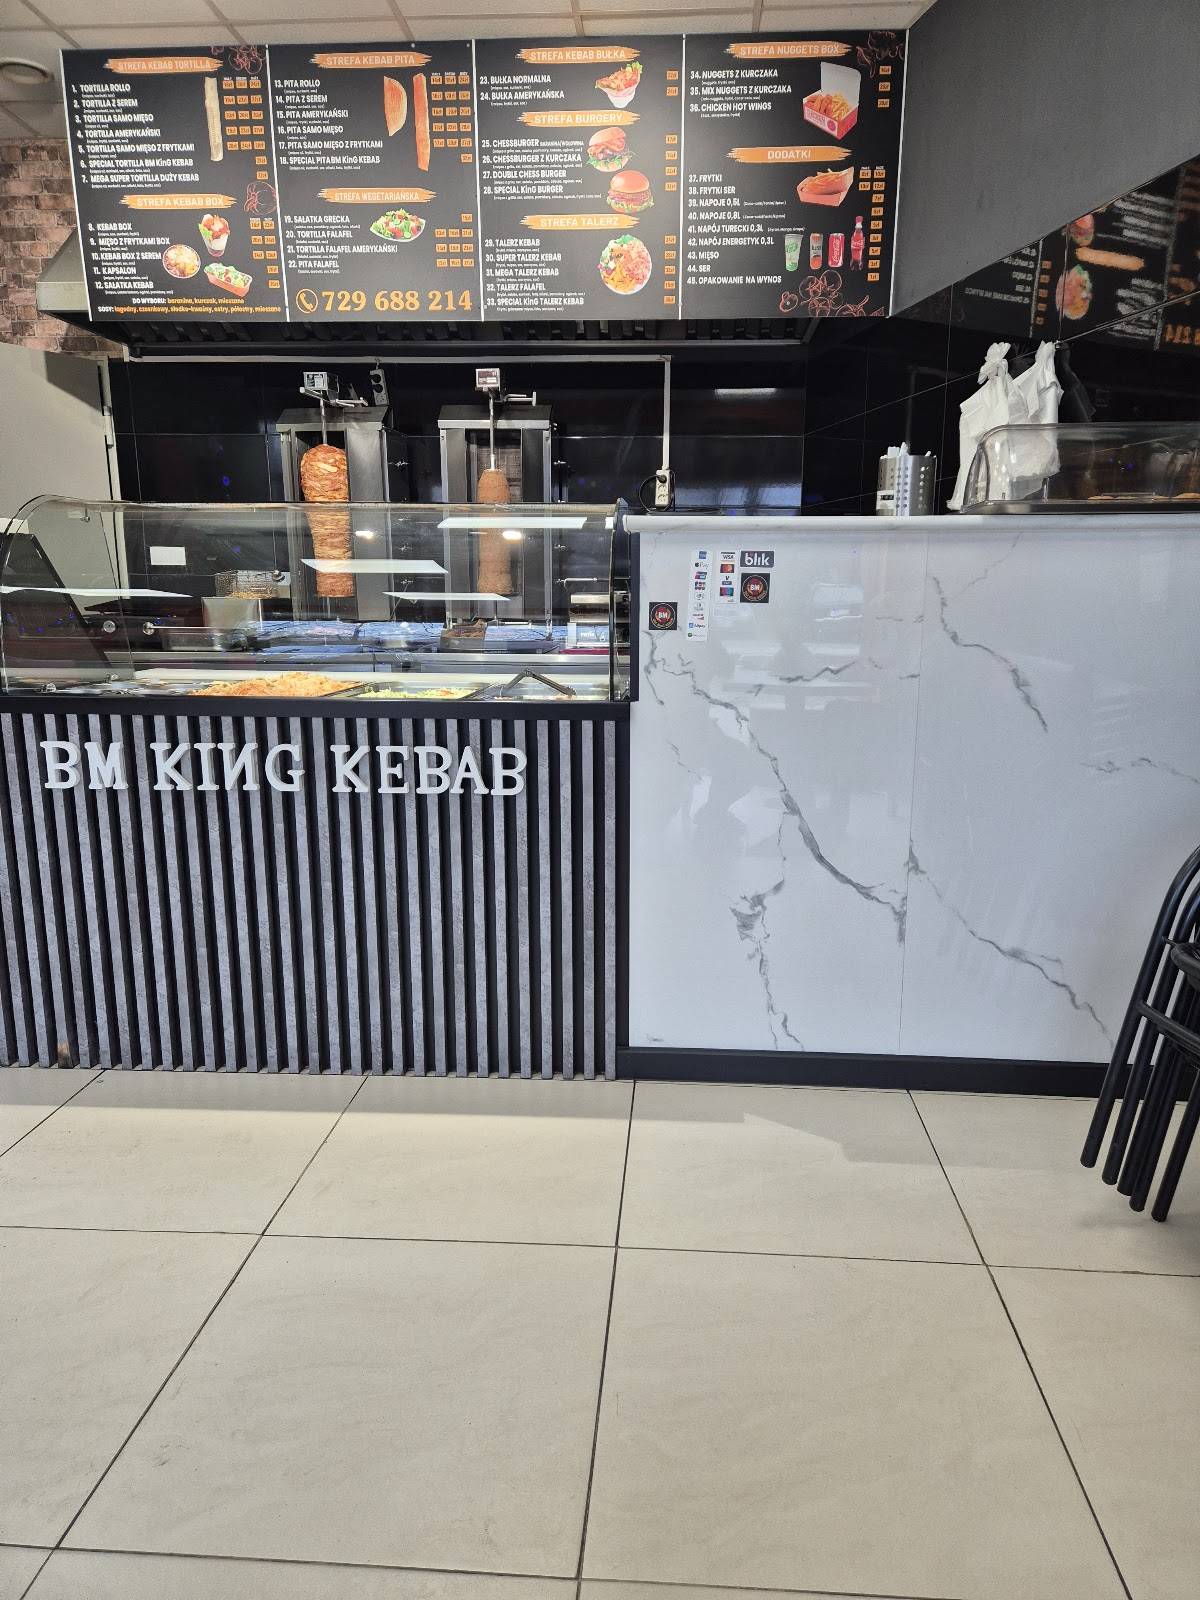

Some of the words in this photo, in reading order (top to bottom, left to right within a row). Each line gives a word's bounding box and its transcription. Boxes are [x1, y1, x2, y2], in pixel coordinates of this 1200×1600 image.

[740, 46, 775, 55] STREFA
[776, 45, 819, 55] NUGGETS
[821, 45, 840, 54] BOX
[326, 56, 361, 65] STREFA
[362, 55, 393, 65] KEBAB
[395, 55, 415, 64] PITA
[530, 51, 563, 61] STREFA
[565, 50, 594, 60] KEBAB
[596, 50, 626, 59] BUŁKA
[702, 70, 734, 78] NUGGETS
[735, 70, 739, 78] Z
[741, 69, 778, 78] KURCZAKA
[300, 79, 320, 87] ROLLO
[491, 76, 512, 84] BUŁKA
[513, 75, 551, 83] NORMALNA
[80, 84, 110, 92] TORTILLA
[110, 84, 131, 92] ROLLO
[702, 87, 715, 95] MIX
[716, 86, 748, 94] NUGGETS
[754, 85, 792, 93] KURCZAKA
[286, 95, 300, 103] PITA
[306, 95, 328, 103] SEREM
[491, 92, 513, 100] BUŁKA
[514, 89, 565, 99] AMERYKAŃSKA
[82, 100, 111, 108] TORTILLA
[112, 99, 116, 107] Z
[116, 99, 138, 107] SEREM
[701, 103, 731, 112] CHICKEN
[733, 103, 747, 111] HOT
[748, 102, 772, 110] WINGS
[302, 108, 349, 118] AMERYKAŃSKI
[83, 115, 112, 123] TORTILLA
[113, 114, 133, 122] SAMO
[133, 114, 154, 123] MIĘSO
[534, 114, 574, 124] STREFA
[575, 113, 623, 123] BURGERY
[85, 130, 114, 138] TORTILLA
[115, 127, 161, 137] AMERYKAŃSKI
[287, 126, 301, 134] PITA
[302, 126, 322, 134] SAMO
[323, 126, 344, 135] MIĘSO
[287, 141, 303, 149] PITA
[304, 141, 323, 149] SAMO
[324, 141, 345, 150] MIĘSO
[345, 141, 349, 149] Z
[350, 140, 383, 149] FRYTKAMI
[493, 139, 539, 148] CHESSBURGER
[86, 145, 116, 153] TORTILLA
[136, 144, 157, 154] MIĘSO
[157, 144, 161, 152] Z
[162, 144, 195, 152] FRYTKAMI
[493, 155, 539, 163] CHESSBURGER
[546, 154, 582, 162] KURCZAKA
[767, 150, 811, 159] DODATKI
[90, 175, 109, 183] MEGA
[110, 174, 130, 182] SUPER
[131, 174, 160, 182] TORTILLA
[160, 172, 177, 182] DUŻY
[178, 173, 199, 181] KEBAB
[493, 171, 518, 179] DOUBLE
[519, 170, 540, 178] CHESS
[540, 170, 567, 178] BURGER
[700, 174, 722, 182] FRYTKI
[494, 186, 520, 194] SPECIAL
[521, 185, 536, 194] KinG
[538, 185, 564, 193] BURGER
[700, 187, 722, 195] FRYTKI
[723, 186, 736, 194] SER
[335, 192, 360, 200] STREFA
[361, 191, 420, 200] WEGETARIAŃSKA
[136, 198, 171, 207] STREFA
[174, 198, 204, 206] KEBAB
[205, 197, 224, 206] BOX
[699, 199, 726, 207] NAPOJE
[294, 215, 323, 223] SAŁATKA
[324, 215, 350, 223] GRECKA
[540, 217, 578, 227] STREFA
[581, 217, 619, 226] TALERZ
[97, 223, 119, 231] KEBAB
[119, 222, 132, 231] BOX
[698, 223, 720, 233] NAPÓJ
[722, 225, 749, 233] TURECKI
[327, 230, 353, 238] FALAFEL
[99, 238, 120, 247] MIĘSO
[124, 237, 156, 245] FRYTKAMI
[157, 237, 170, 245] BOX
[495, 239, 518, 247] TALERZ
[699, 236, 721, 246] NAPÓJ
[722, 237, 759, 246] ENERGETYK
[760, 237, 774, 246] 0,3L
[296, 245, 325, 253] TORTILLA
[326, 245, 352, 253] FALAFEL
[352, 243, 398, 253] AMERYKAŃSKI
[101, 252, 121, 260] KEBAB
[121, 252, 135, 260] BOX
[141, 252, 162, 260] SEREM
[496, 253, 517, 261] SUPER
[517, 253, 540, 261] TALERZ
[541, 253, 562, 261] KEBAB
[699, 252, 720, 261] MIĘSO
[299, 260, 313, 268] PITA
[313, 260, 340, 268] FALAFEL
[699, 264, 711, 272] SER
[515, 268, 537, 276] TALERZ
[538, 268, 559, 276] KEBAB
[699, 276, 744, 285] OPAKOWANIE
[746, 276, 756, 284] NA
[757, 275, 782, 283] WYNOS
[104, 281, 133, 289] SAŁATKA
[133, 281, 154, 289] KEBAB
[497, 283, 519, 291] TALERZ
[520, 283, 546, 291] FALAFEL
[321, 290, 367, 312] 729
[374, 290, 420, 312] 688
[428, 290, 473, 312] 214
[497, 298, 523, 306] SPECIAL
[523, 297, 539, 306] KinG
[563, 297, 584, 305] KEBAB
[744, 552, 770, 566] blik
[40, 740, 129, 791] BM
[330, 744, 528, 797] KEBAB
